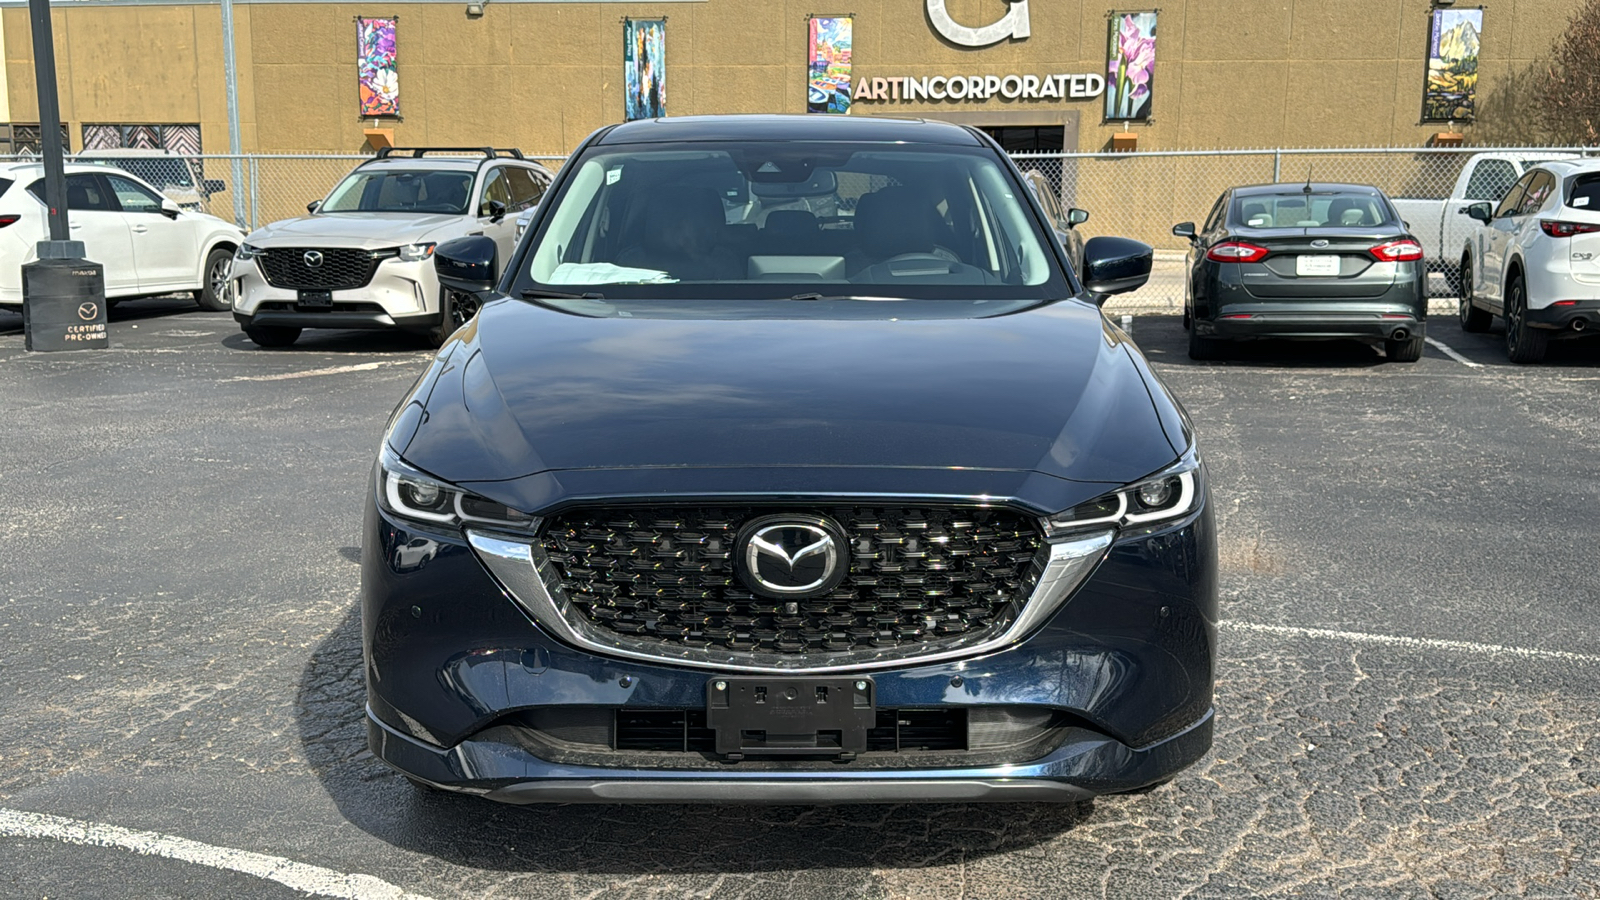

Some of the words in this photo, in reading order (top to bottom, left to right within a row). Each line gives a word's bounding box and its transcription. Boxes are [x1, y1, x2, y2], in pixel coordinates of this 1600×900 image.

[853, 73, 1105, 100] ARTINCORPORATED
[67, 323, 105, 333] CERTIFIED
[64, 331, 107, 341] PRE-OWNED
